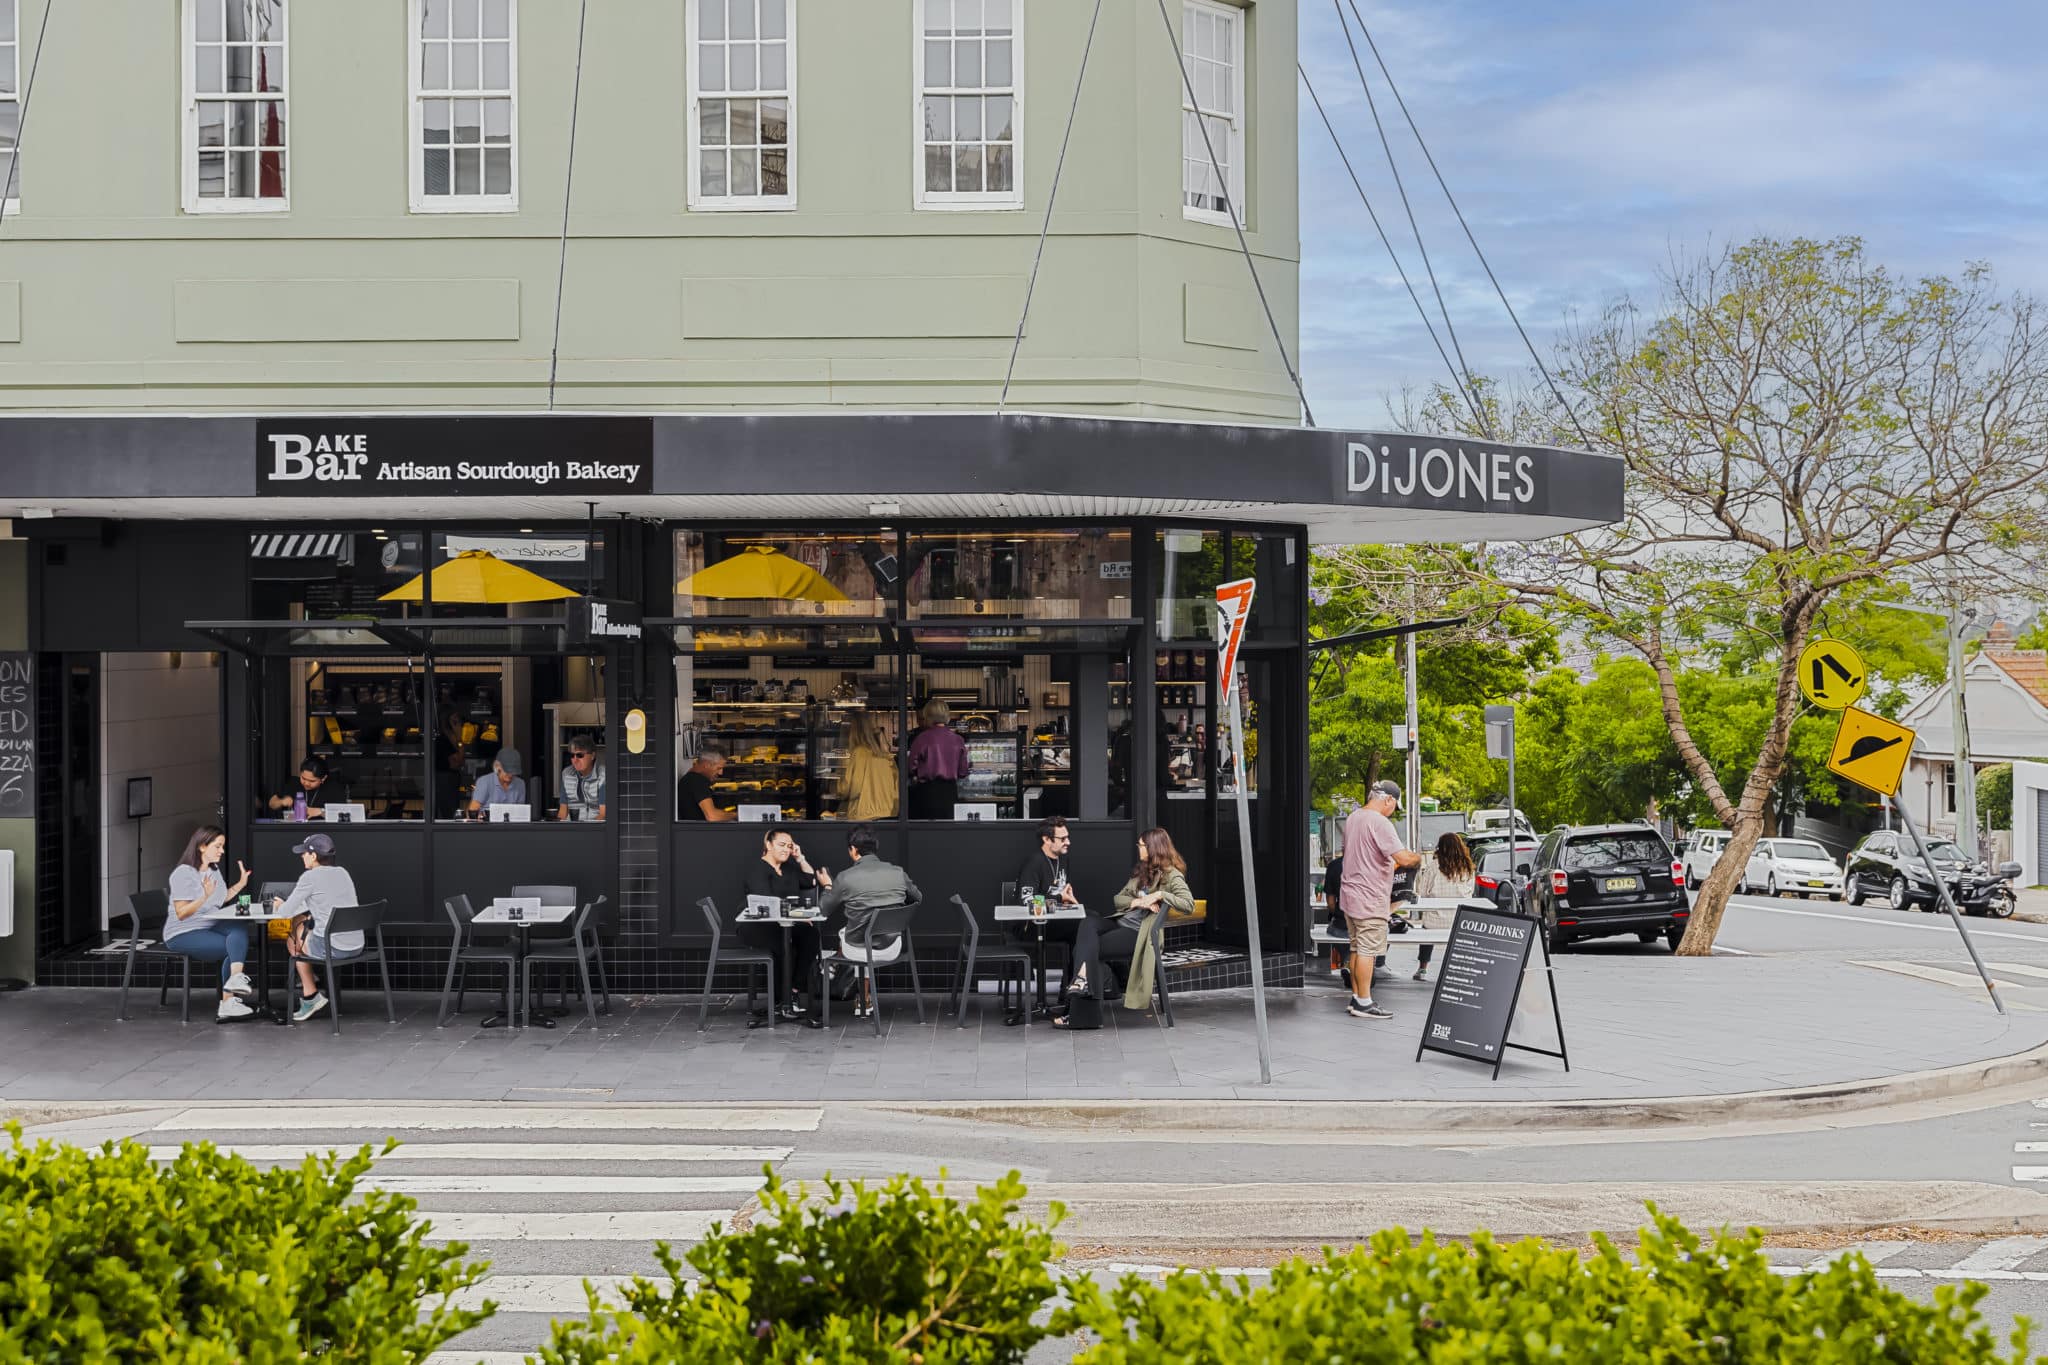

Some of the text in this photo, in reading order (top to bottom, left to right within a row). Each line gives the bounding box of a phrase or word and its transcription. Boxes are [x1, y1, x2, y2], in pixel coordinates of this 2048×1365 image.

[267, 433, 369, 481] Bar
[376, 460, 641, 484] Artisan Sourdough Bakery
[1347, 442, 1535, 503] DiJONES
[1460, 919, 1526, 939] COLD DRINKS
